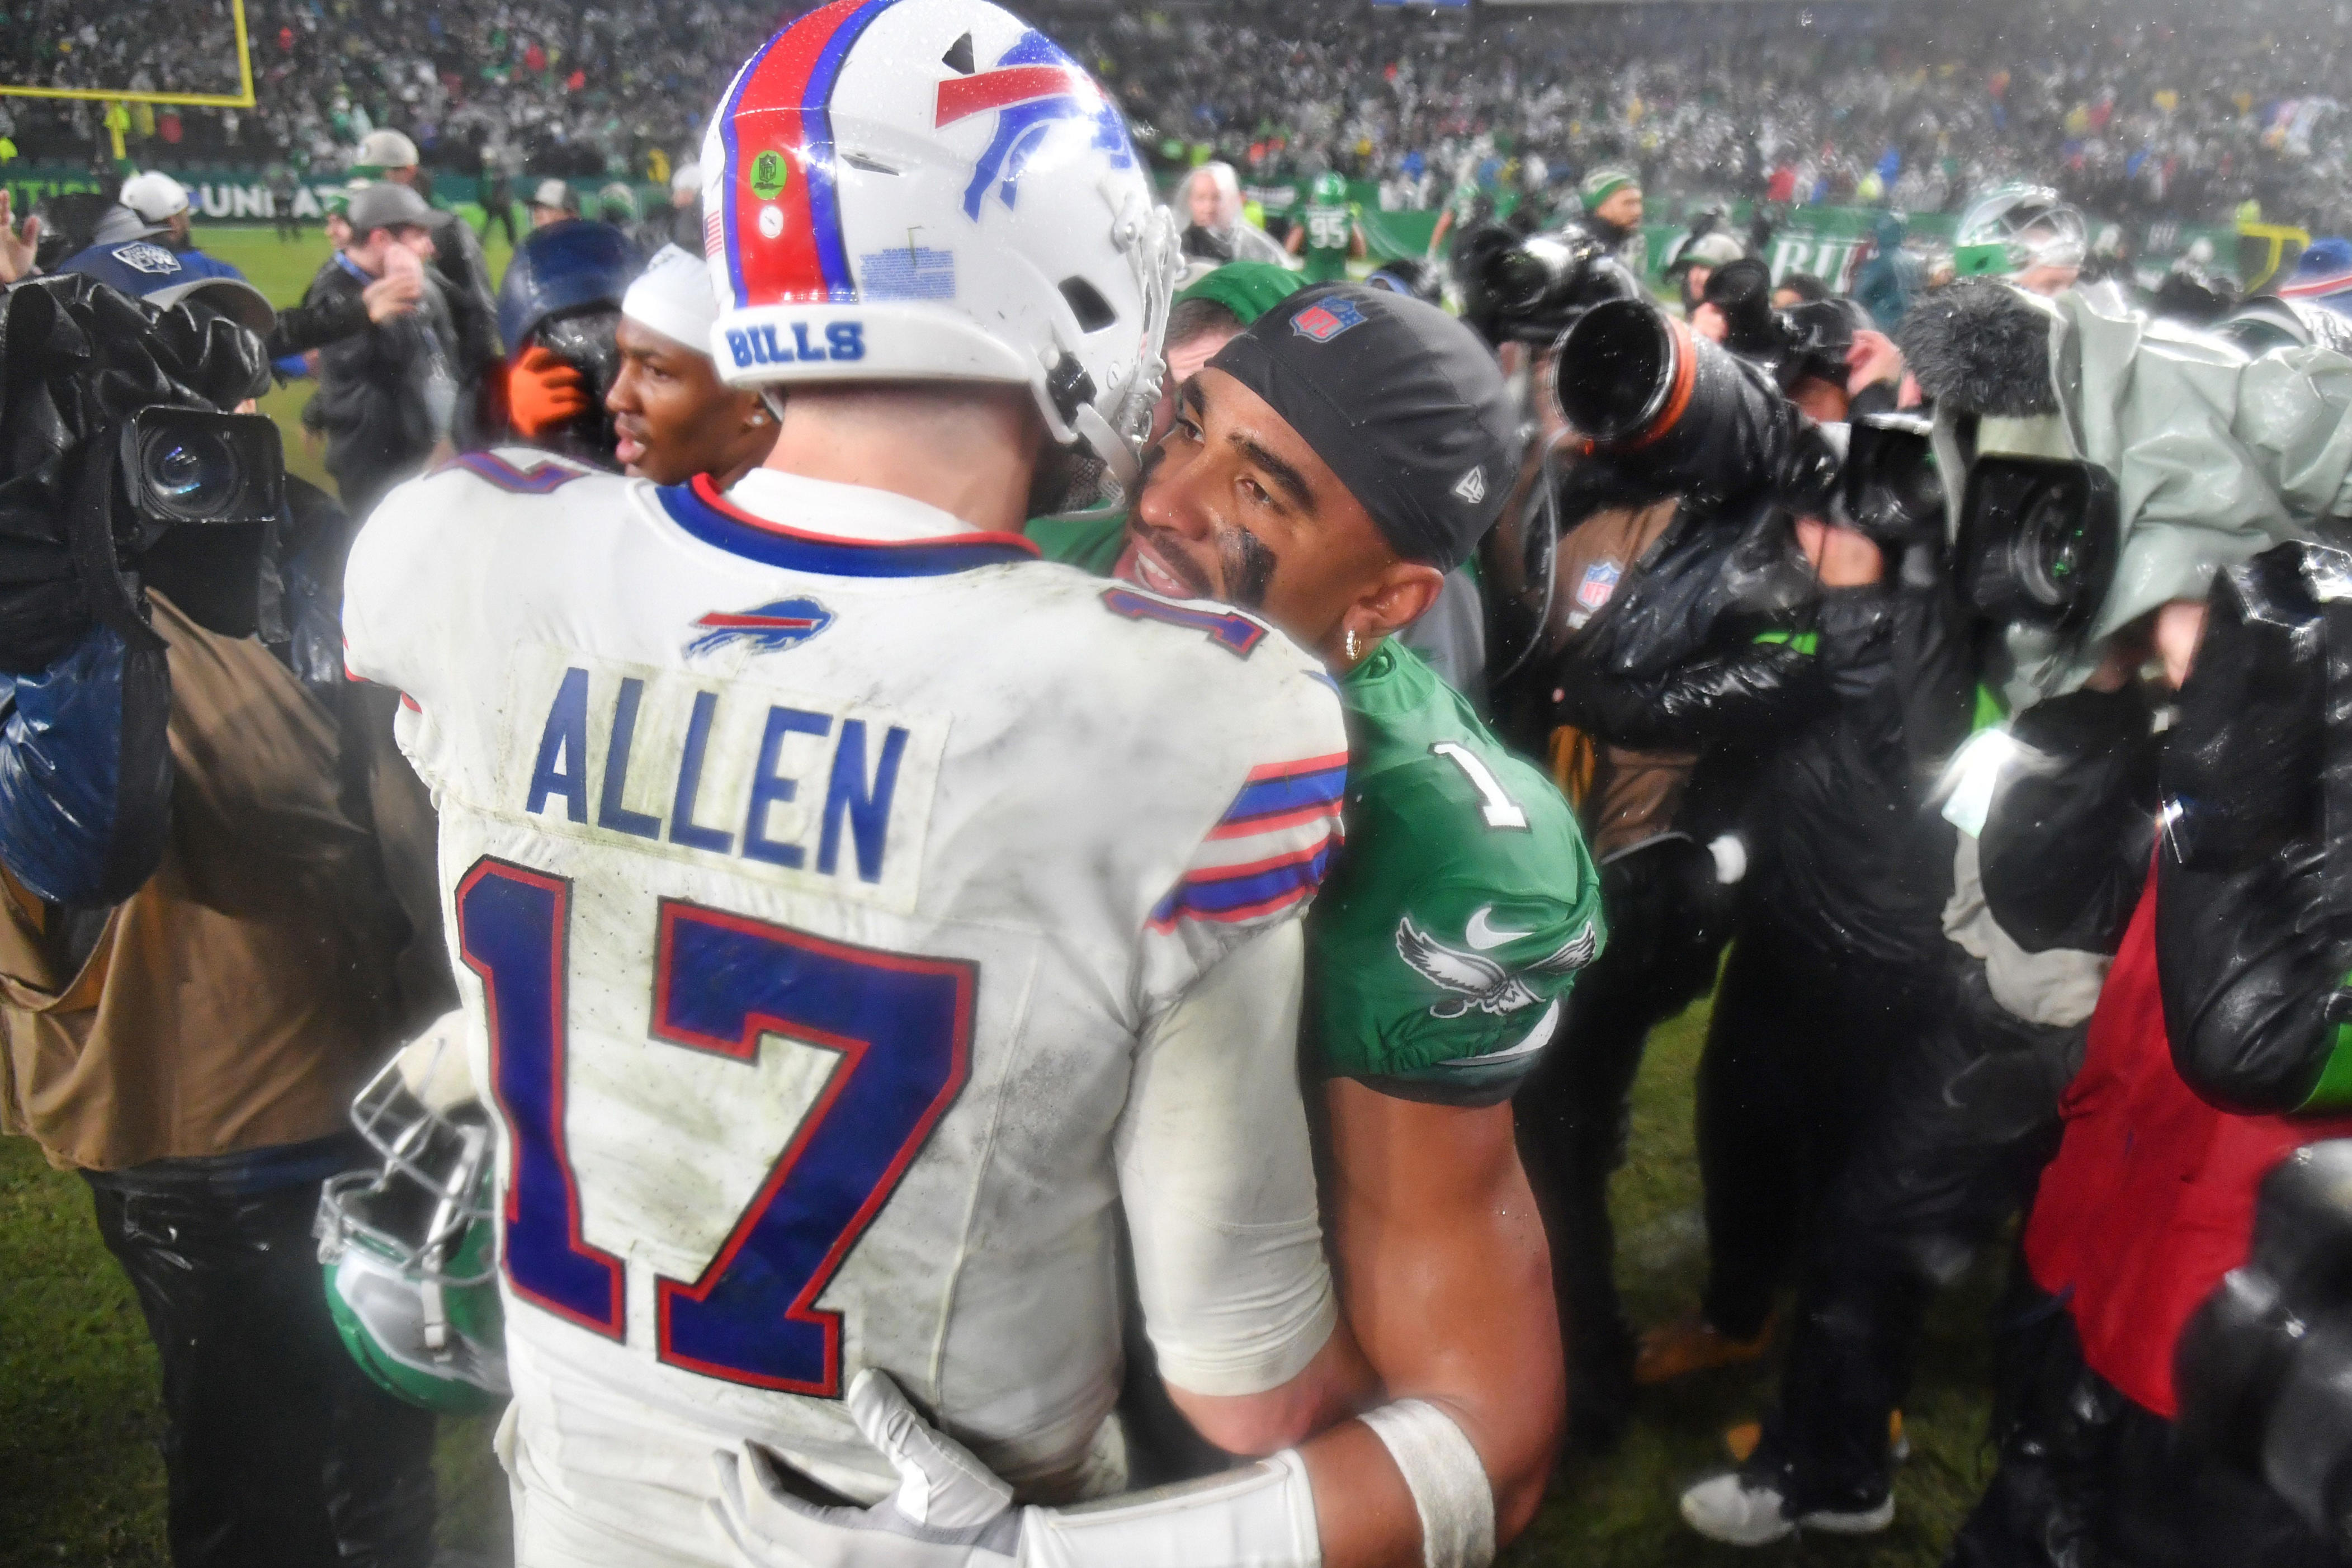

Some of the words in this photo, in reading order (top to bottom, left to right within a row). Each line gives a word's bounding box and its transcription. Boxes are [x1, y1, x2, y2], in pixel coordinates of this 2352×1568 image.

[1310, 216, 1349, 249] 95
[725, 320, 866, 368] BILLS
[525, 667, 910, 885] ALLEN
[1427, 740, 1533, 834] 1
[454, 853, 980, 1400] 17
